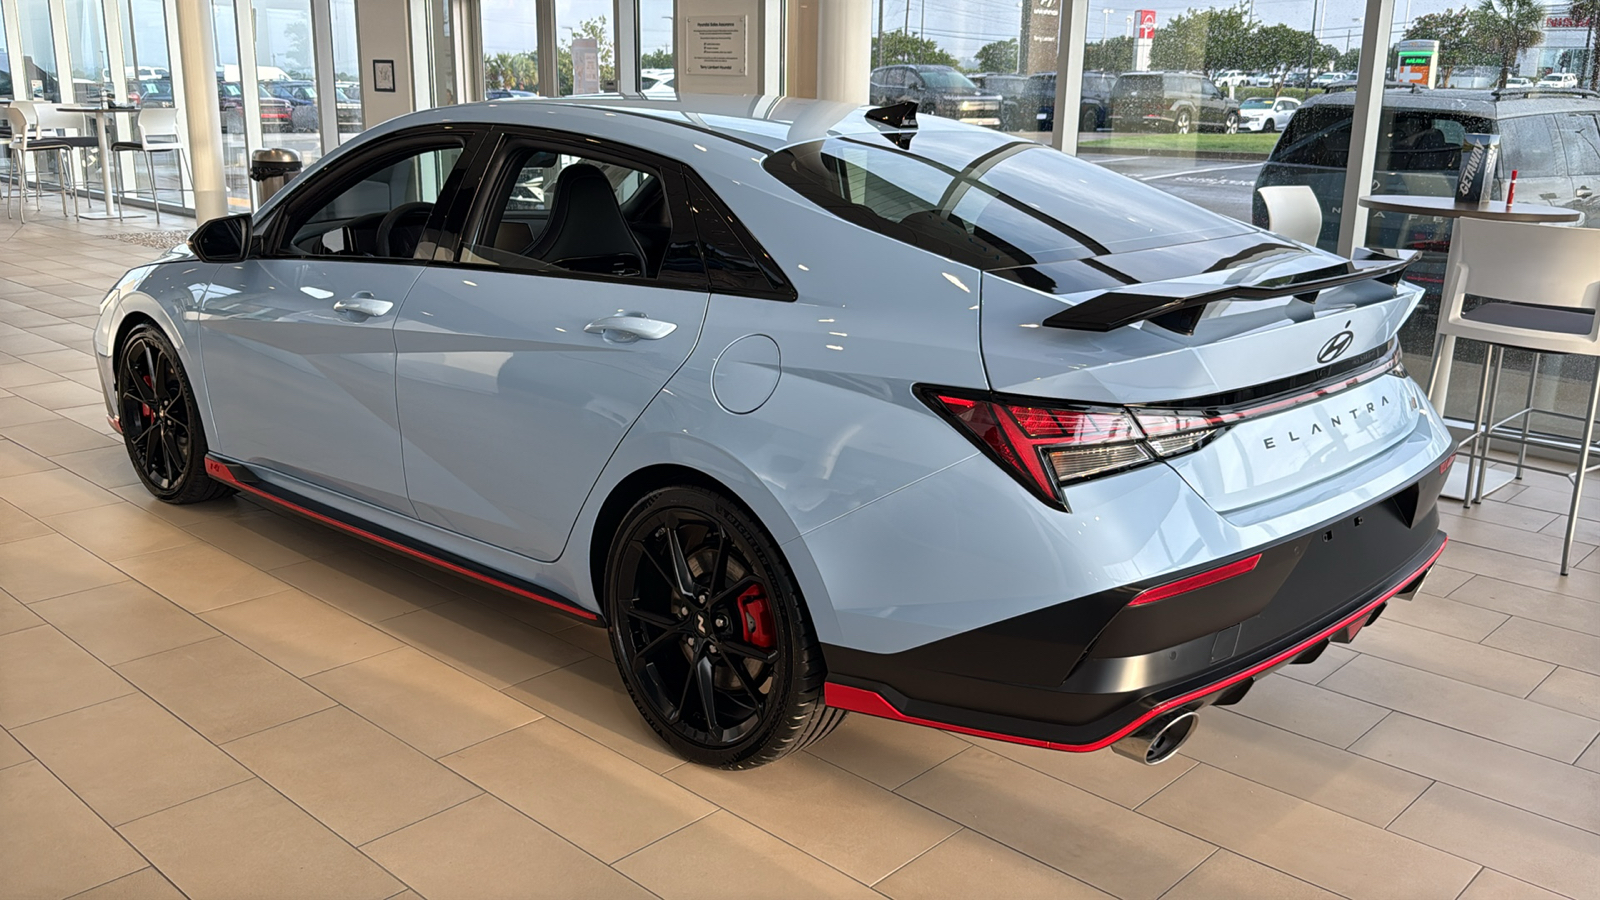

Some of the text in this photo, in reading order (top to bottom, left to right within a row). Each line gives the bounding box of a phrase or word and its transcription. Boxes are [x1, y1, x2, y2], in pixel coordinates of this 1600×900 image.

[1459, 138, 1485, 196] GETAWAY
[1263, 396, 1390, 450] ELANTRA
[725, 513, 768, 566] MICHELIN
